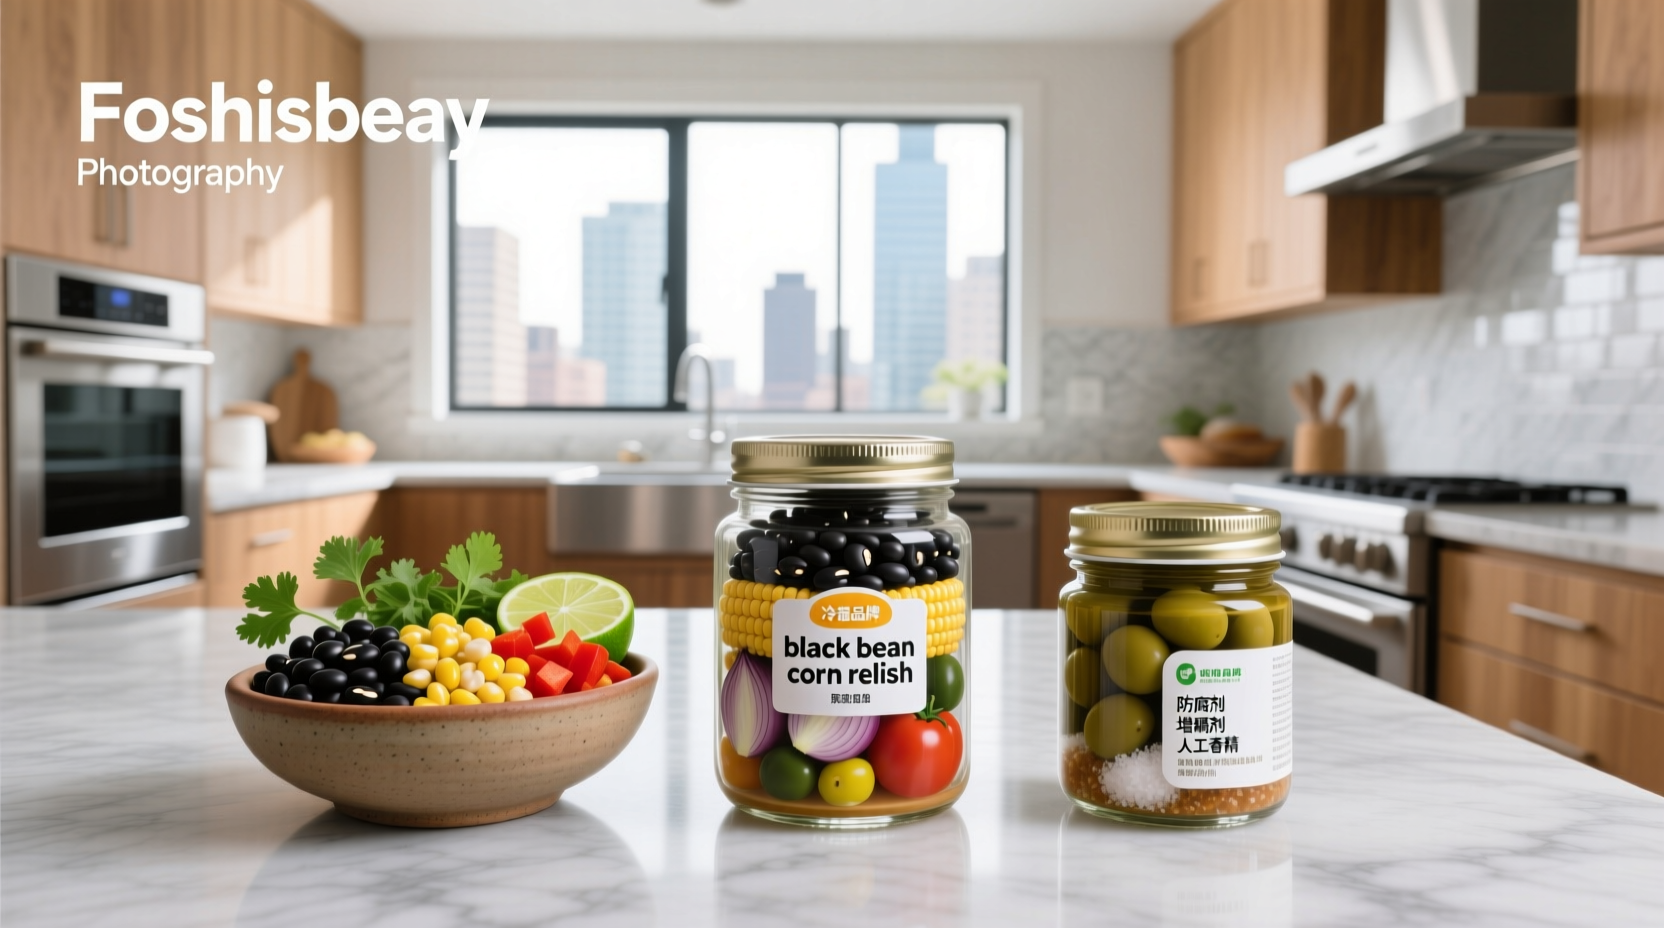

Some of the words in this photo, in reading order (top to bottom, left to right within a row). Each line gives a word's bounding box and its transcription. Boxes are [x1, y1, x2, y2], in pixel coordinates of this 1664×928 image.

[784, 635, 851, 658] black
[856, 636, 915, 658] bean
[787, 667, 842, 685] corn
[848, 661, 913, 685] relish
